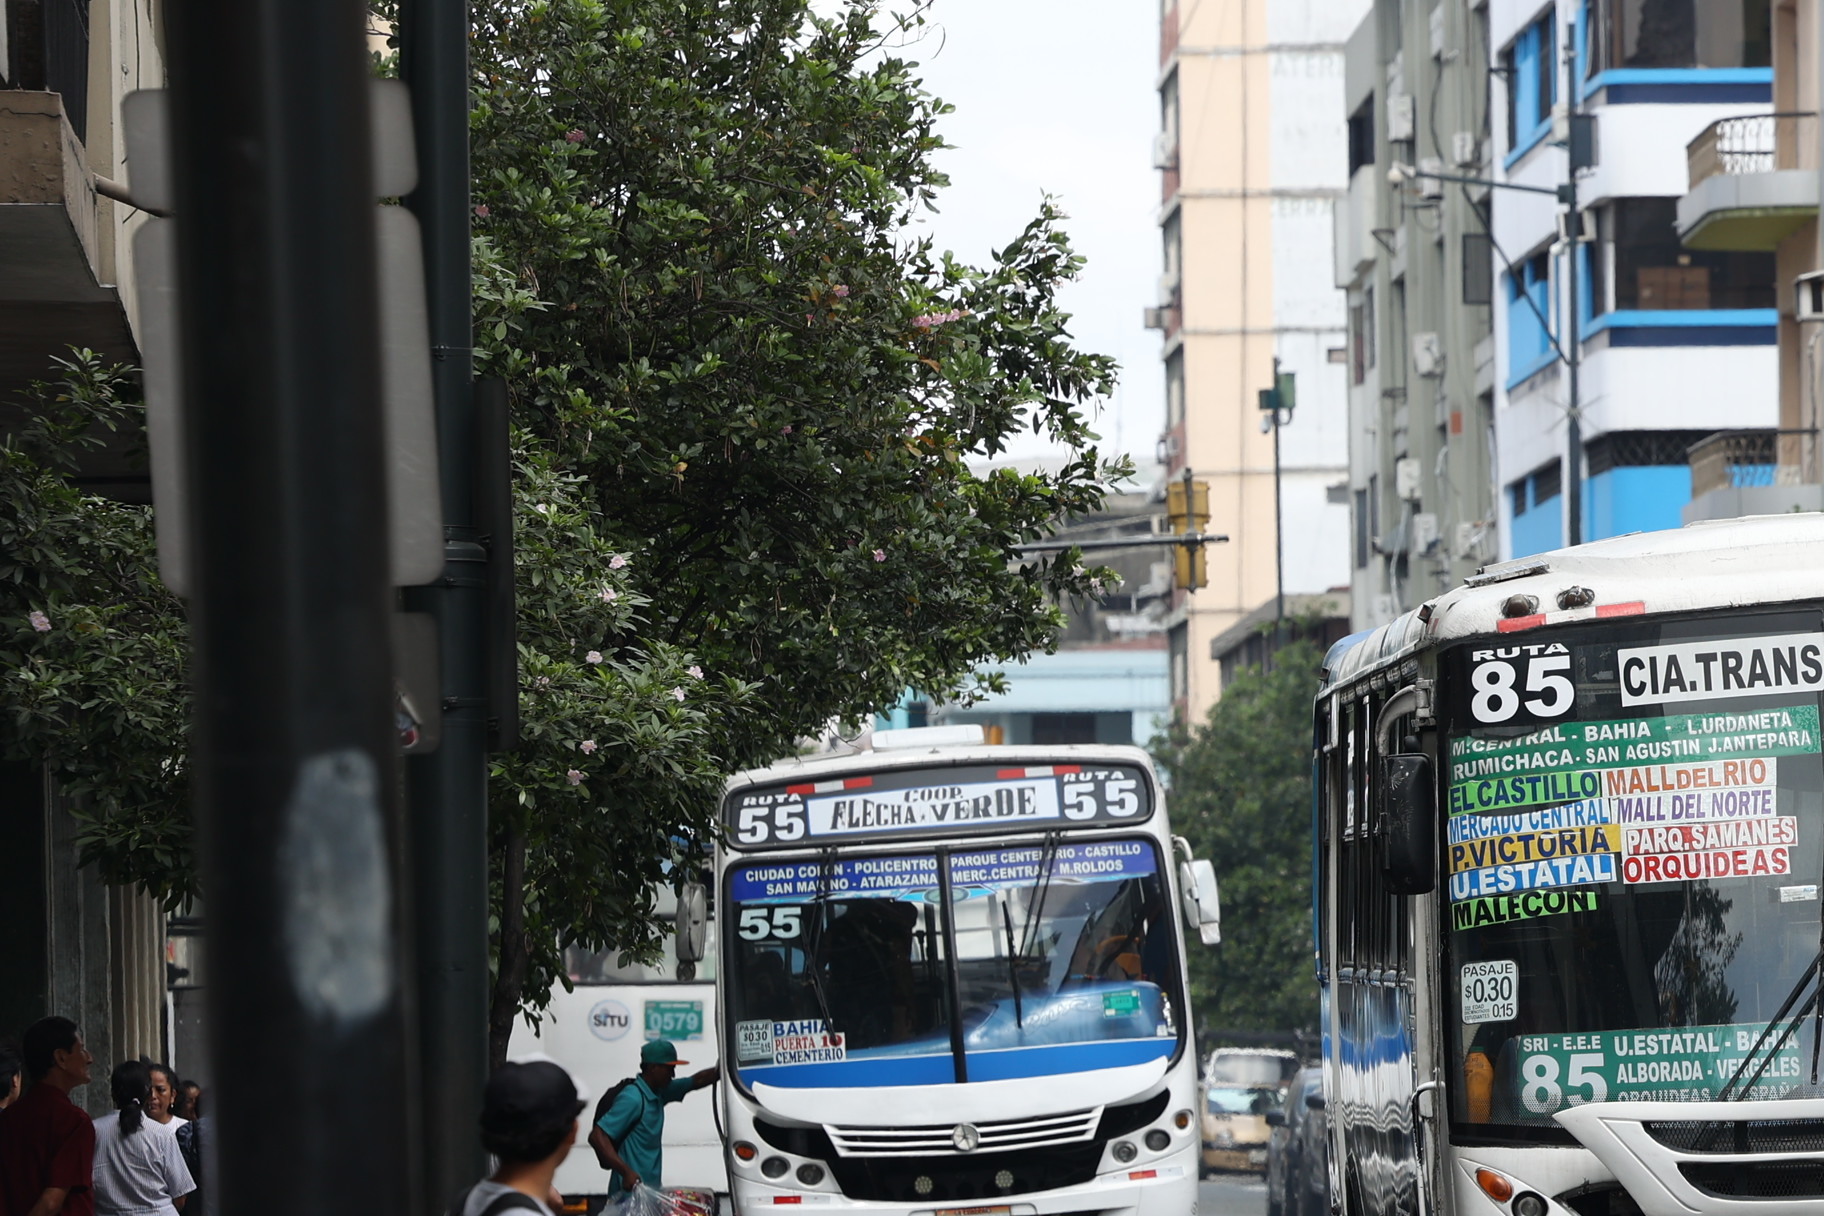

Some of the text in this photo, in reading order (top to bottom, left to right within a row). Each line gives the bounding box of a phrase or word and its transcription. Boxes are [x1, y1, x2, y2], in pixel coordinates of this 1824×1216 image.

[1472, 643, 1570, 662] RUTA
[1471, 655, 1575, 723] 85
[1584, 722, 1651, 741] BAHIA
[1688, 712, 1792, 735] L.URDANETA
[1453, 730, 1812, 781] RUMICHACA SAN AGUSTIN J.ANTEPARA
[1064, 770, 1125, 782] RUTA
[743, 793, 802, 806] RUTA
[1064, 780, 1138, 820] 55
[1450, 771, 1598, 814] EL CASTILLO
[830, 787, 1036, 830] FLECHA VERDE
[1617, 790, 1772, 824] MALL DEL NORTE
[738, 804, 805, 843] 55
[1450, 798, 1609, 845] MERCADO CENTRAL
[951, 854, 997, 868] PARQUE
[1085, 844, 1141, 857] CASTILLO
[1452, 827, 1610, 872] P.VICTORIA
[746, 867, 795, 882] CIUDAD
[855, 859, 938, 875] POLICENTRO
[1060, 860, 1124, 874] M.ROLDOS
[1452, 855, 1612, 899] U.ESTATAL
[1624, 847, 1788, 883] ORQUIDEAS
[766, 874, 938, 896] SAN MARNO ATARAZANA
[1454, 889, 1590, 930] MALECON
[738, 907, 802, 940] 55
[1464, 963, 1513, 978] PASAJE
[1465, 976, 1512, 1003] $0.30
[650, 1012, 698, 1030] 0579
[1492, 1003, 1513, 1018] 0.15
[774, 1020, 830, 1036] BAHIA
[775, 1036, 816, 1051] PUERTA
[776, 1048, 843, 1065] CEMENTERIO
[1523, 1037, 1549, 1052] SRI
[1614, 1032, 1719, 1056] U.ESTATAL
[1521, 1052, 1608, 1113] 85
[1617, 1059, 1703, 1084] ALBORADA
